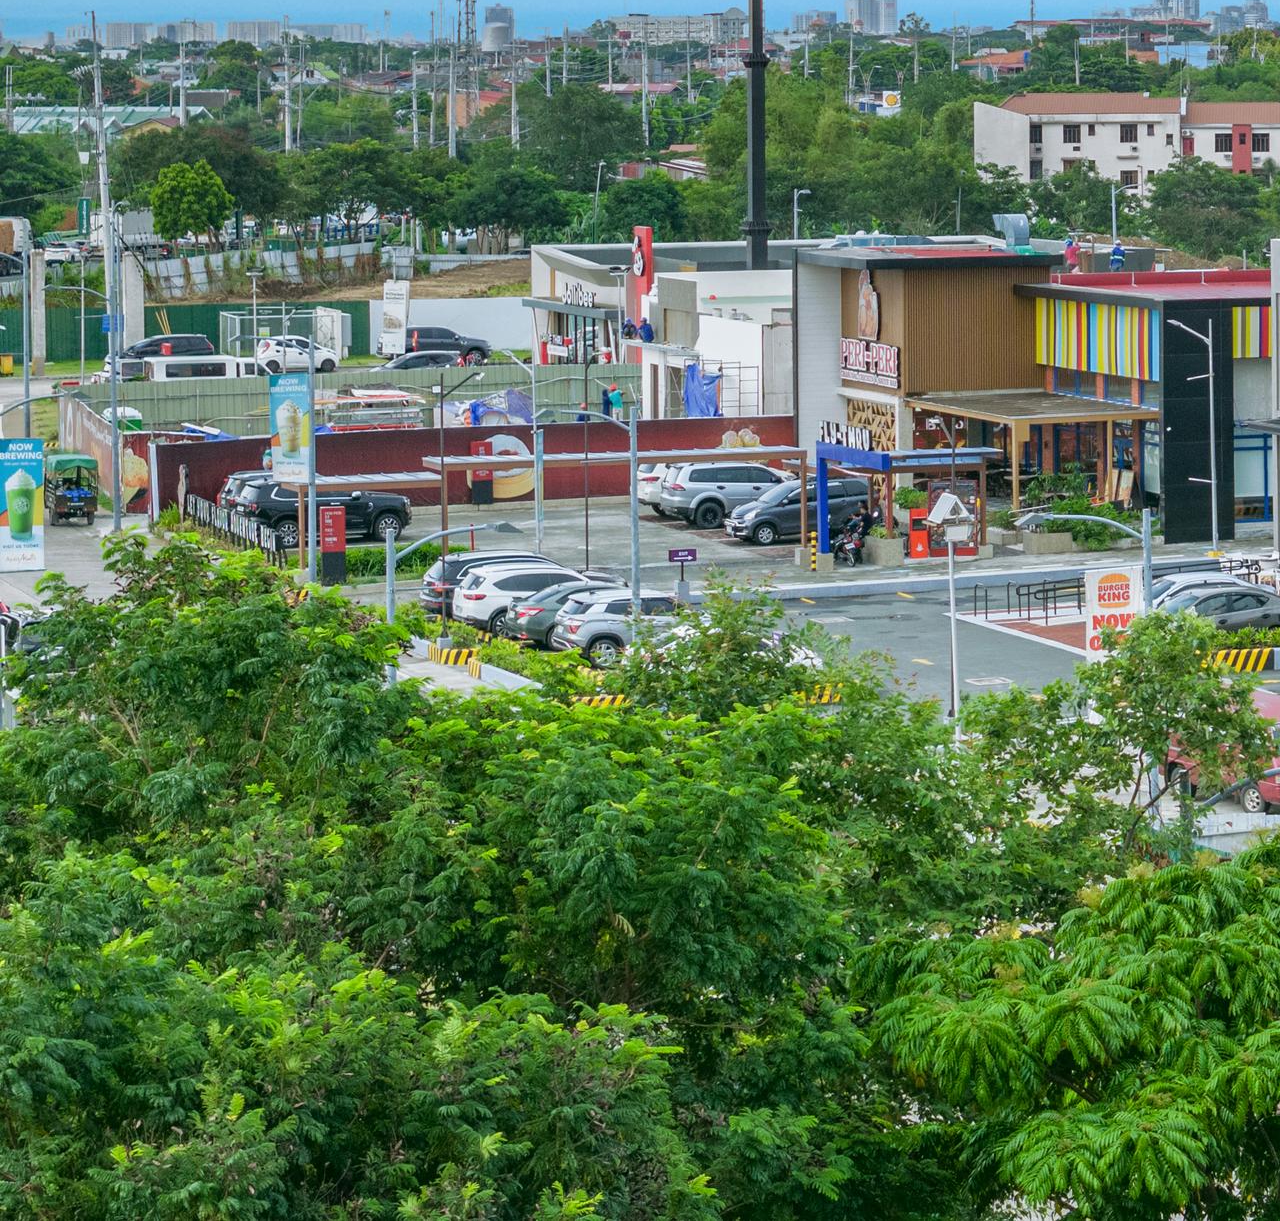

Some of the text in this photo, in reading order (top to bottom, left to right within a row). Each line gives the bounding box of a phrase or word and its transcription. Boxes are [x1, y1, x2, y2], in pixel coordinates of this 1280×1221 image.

[562, 282, 594, 308] Jollibee
[840, 337, 898, 377] PERI-PERI
[8, 443, 33, 452] NOW
[0, 451, 43, 460] BREWING
[1098, 583, 1130, 593] BURGER
[1098, 591, 1130, 603] KING
